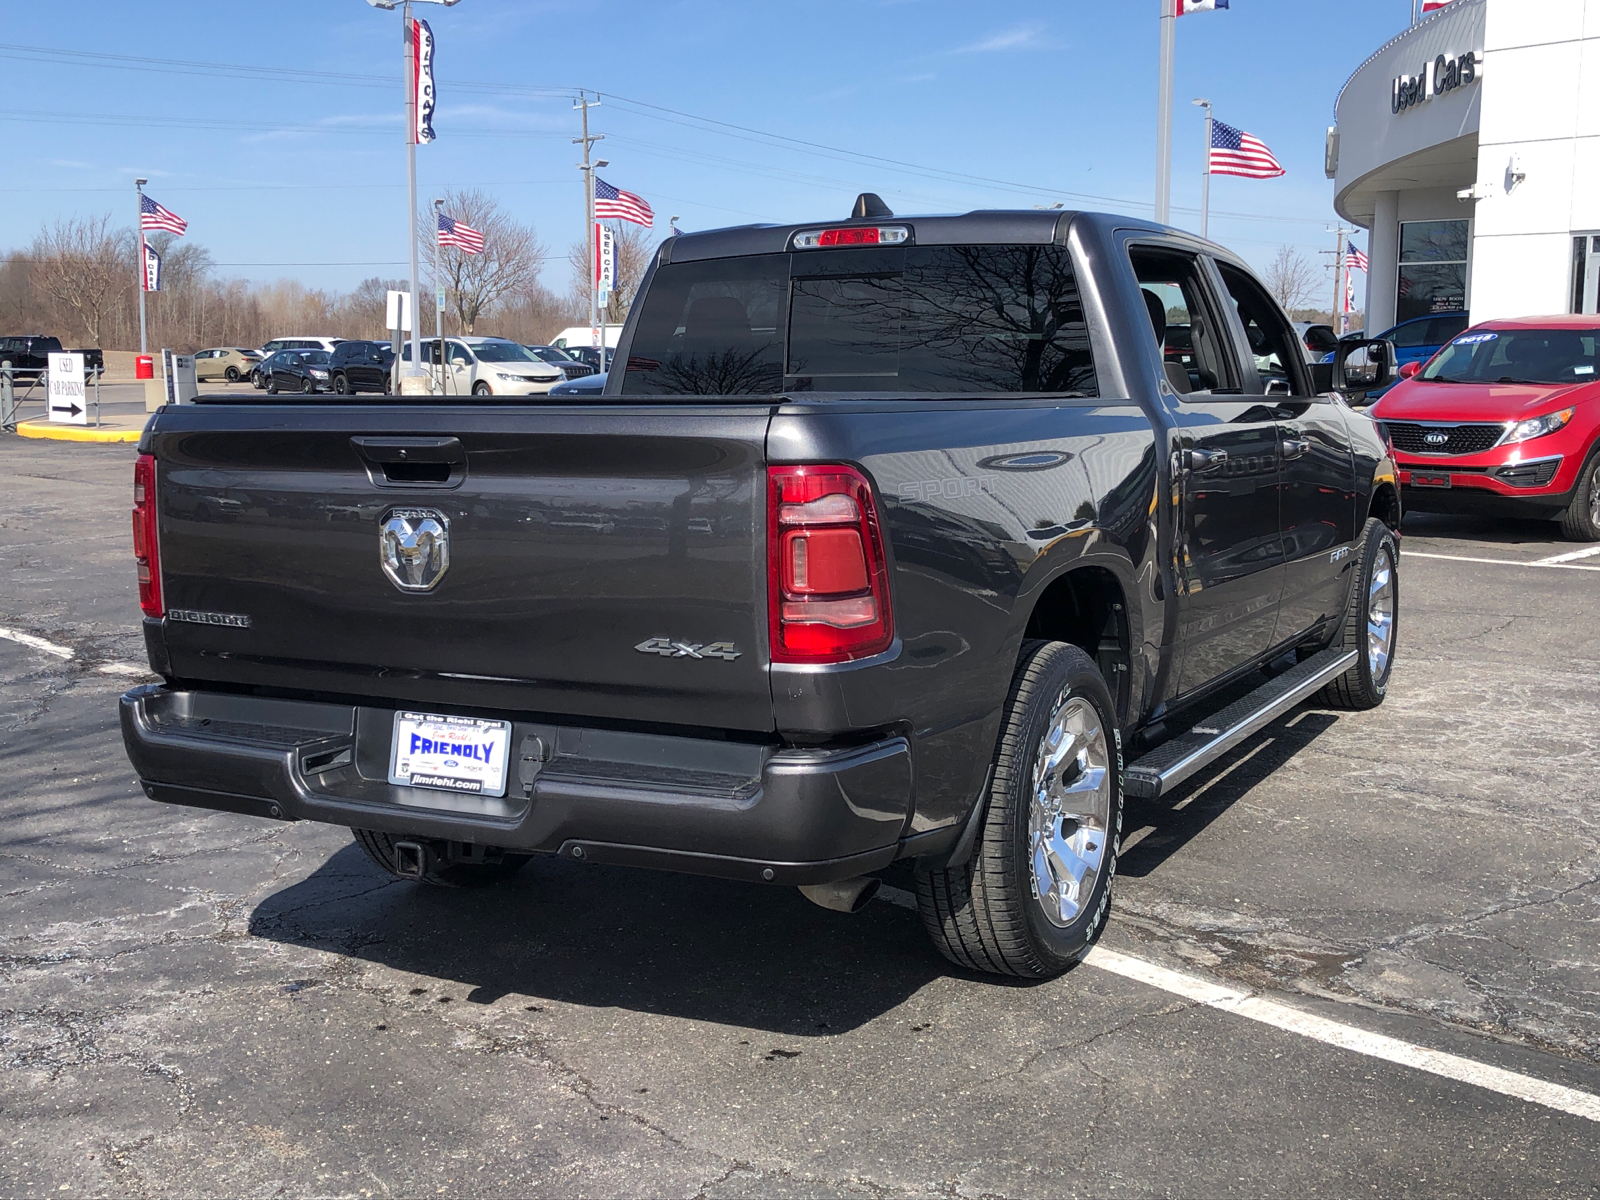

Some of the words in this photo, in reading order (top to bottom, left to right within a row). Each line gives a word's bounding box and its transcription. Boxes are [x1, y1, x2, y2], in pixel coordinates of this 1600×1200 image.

[1391, 61, 1428, 115] Used
[1433, 51, 1476, 96] Cars
[58, 357, 74, 373] USED
[49, 380, 61, 396] CAR
[61, 381, 85, 397] PARKING
[1427, 435, 1443, 443] KIA
[898, 475, 999, 504] SPORT
[404, 713, 424, 721] Get
[410, 732, 495, 764] FRIENDLY
[411, 774, 480, 790] jimriehl.com
